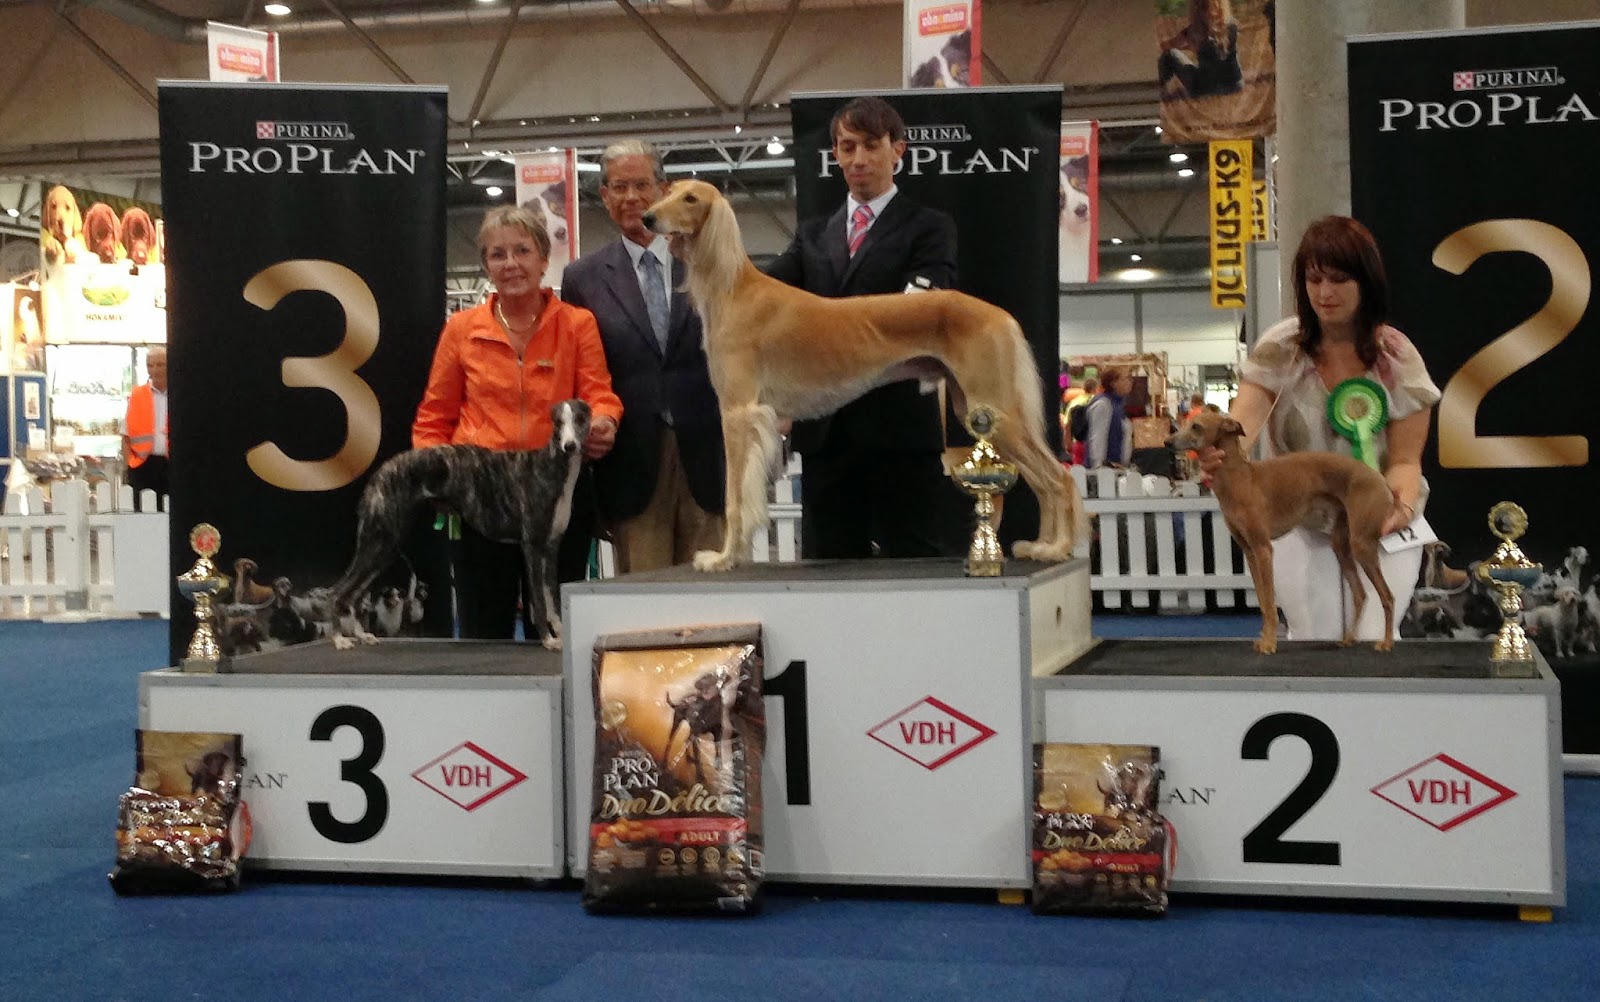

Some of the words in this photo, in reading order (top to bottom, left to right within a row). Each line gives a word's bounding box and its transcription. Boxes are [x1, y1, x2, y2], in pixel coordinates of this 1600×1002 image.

[1475, 70, 1553, 87] PURINA
[276, 125, 345, 138] PURINA
[903, 127, 963, 141] URINA
[1215, 149, 1246, 306] JULIUS-K9
[1432, 218, 1592, 469] 2
[243, 259, 382, 492] 3
[763, 660, 811, 805] 1
[900, 721, 956, 745] VDH
[307, 704, 390, 844] 3
[441, 764, 492, 787] VDH
[611, 756, 651, 774] PRO
[603, 772, 659, 791] PLAN
[1241, 712, 1342, 866] 2
[1408, 779, 1471, 805] VDH
[680, 831, 721, 842] ADULT
